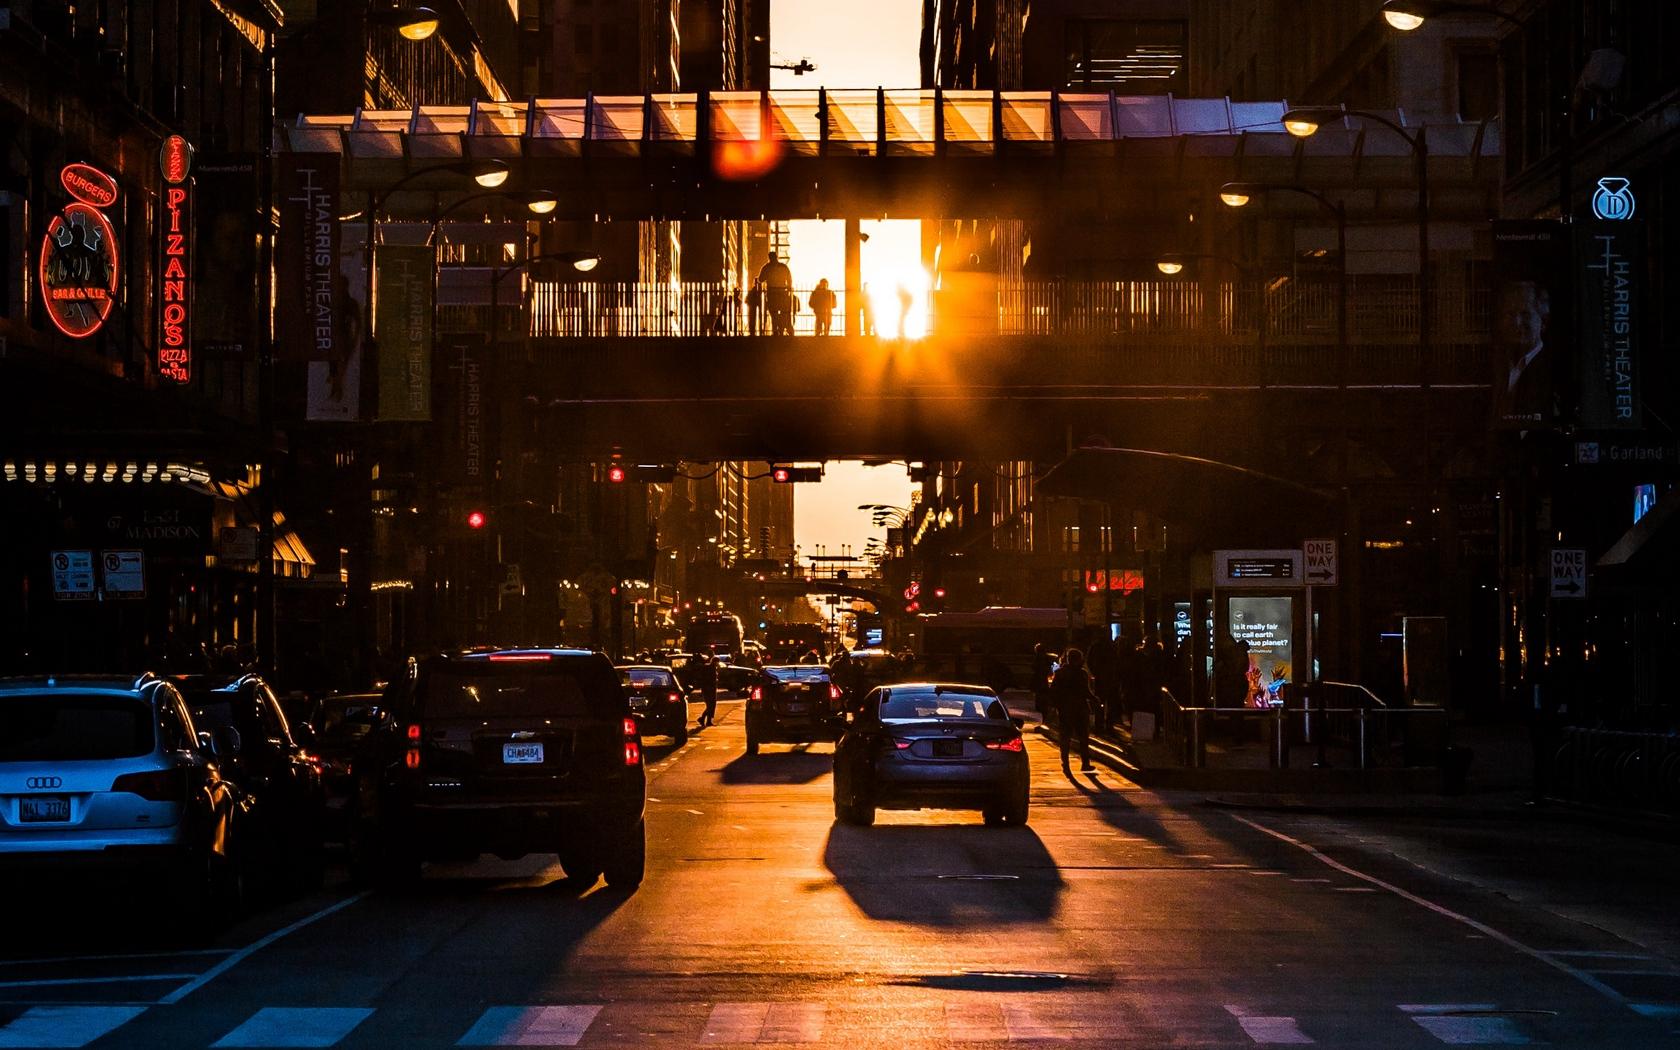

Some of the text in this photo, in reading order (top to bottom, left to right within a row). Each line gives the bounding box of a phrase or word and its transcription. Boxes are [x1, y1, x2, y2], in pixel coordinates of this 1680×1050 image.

[65, 171, 112, 204] BURGERS
[315, 194, 332, 350] HARRIS THEATER
[409, 280, 424, 412] HARRIS THEATER
[1614, 261, 1632, 420] HARRIS THEATER
[160, 349, 187, 364] PIZZA
[466, 363, 481, 476] HARRIS THEATER
[1610, 445, 1664, 460] Garland
[126, 526, 201, 539] MADISON
[1307, 543, 1332, 554] ONE
[1307, 556, 1334, 567] WAY
[1553, 552, 1583, 564] ONE
[1553, 566, 1584, 578] WAY
[1262, 639, 1288, 647] planet?
